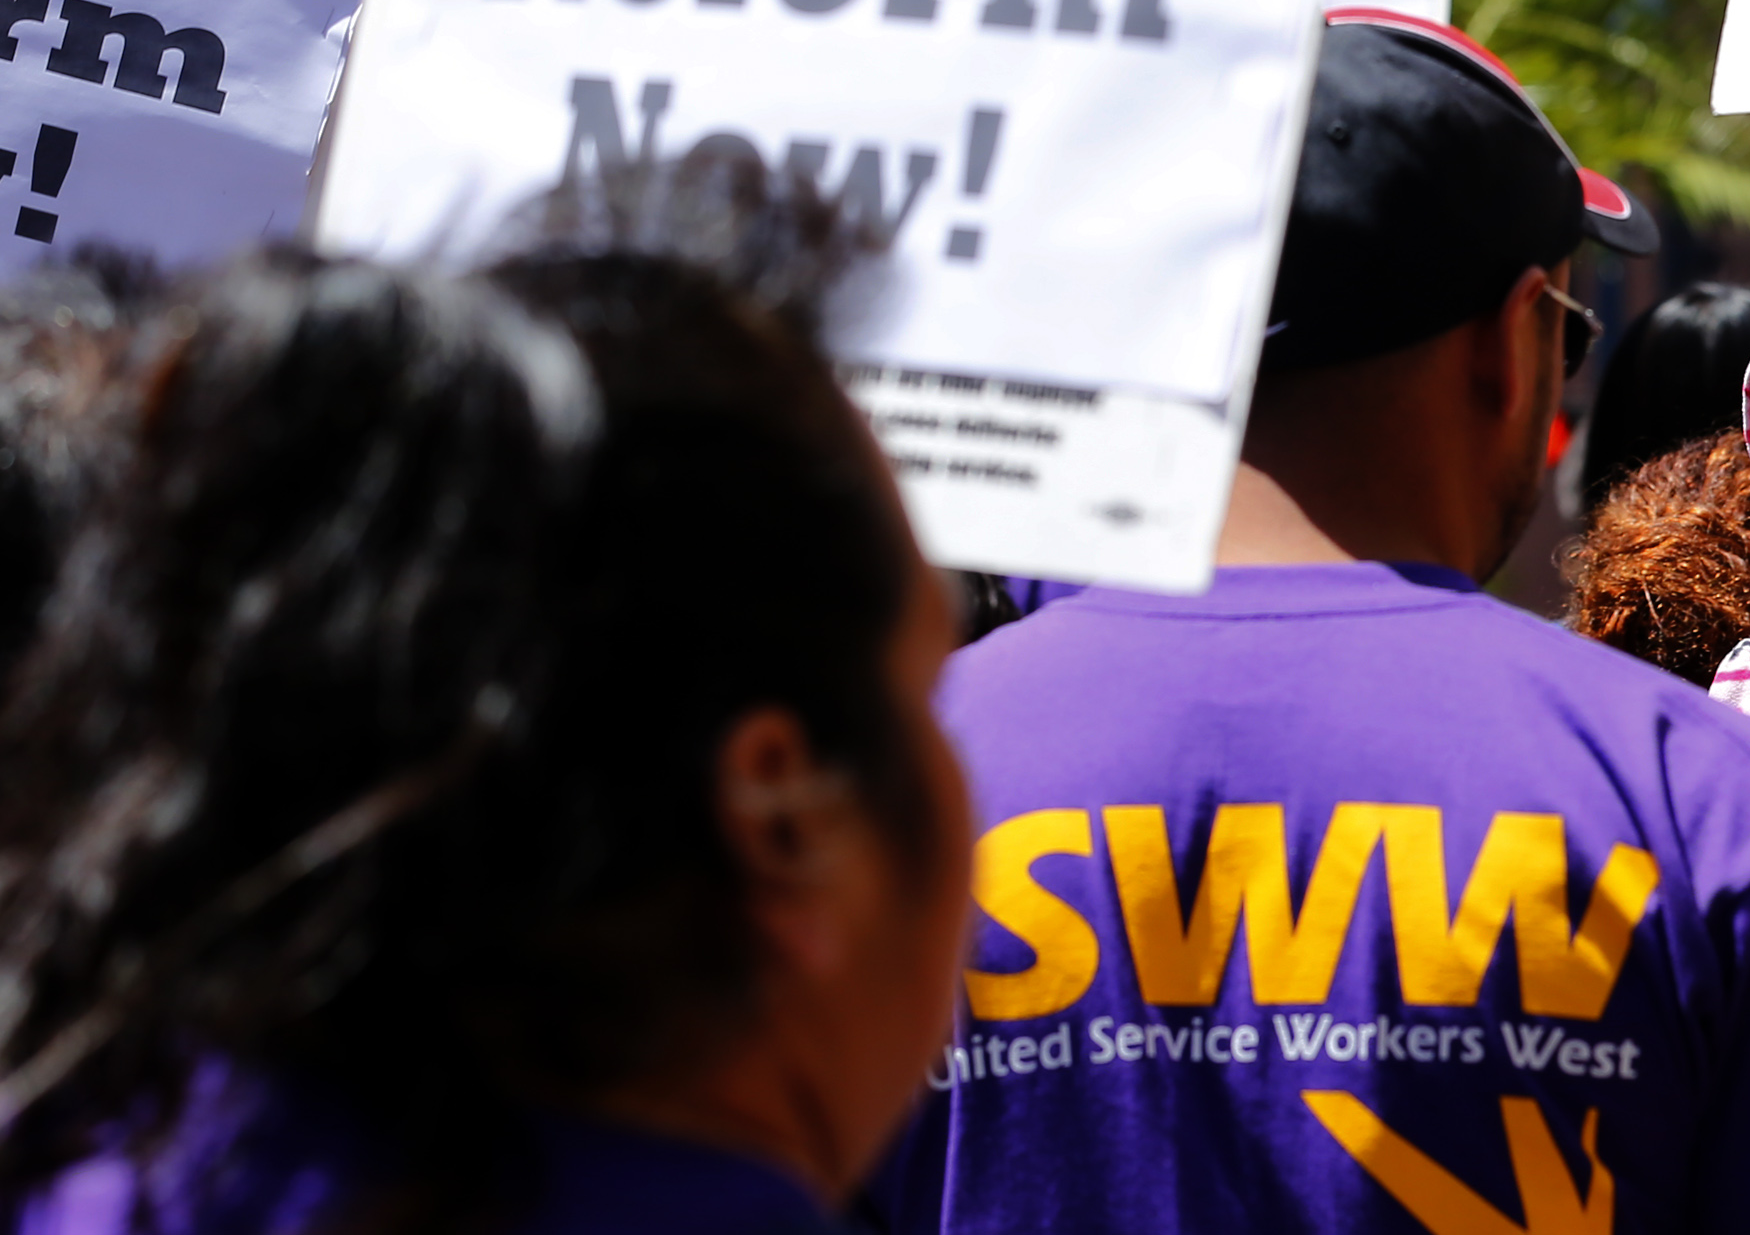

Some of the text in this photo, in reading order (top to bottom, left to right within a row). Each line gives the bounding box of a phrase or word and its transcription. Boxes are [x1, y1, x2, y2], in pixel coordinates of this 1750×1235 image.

[1088, 1014, 1260, 1064] Service
[1272, 1011, 1486, 1065] Workers
[1500, 1020, 1641, 1080] West
